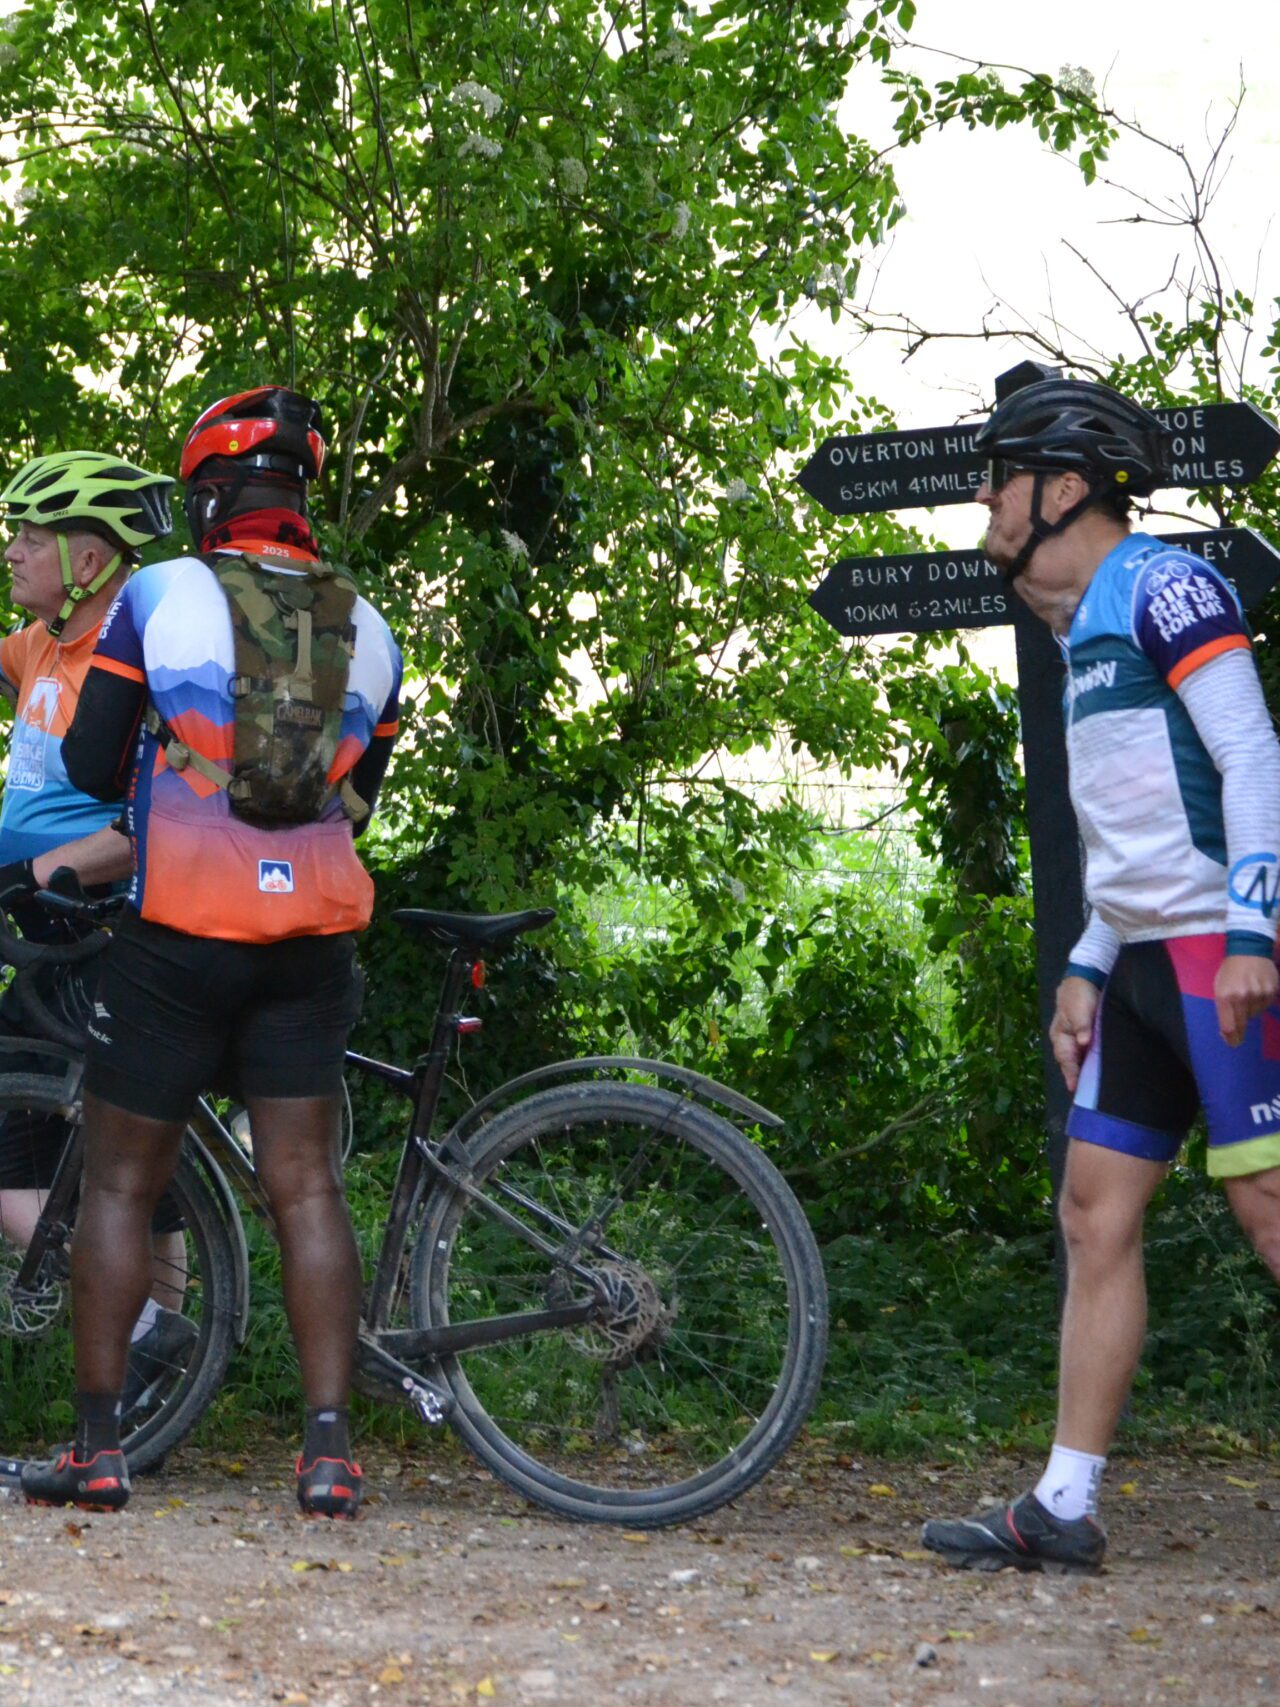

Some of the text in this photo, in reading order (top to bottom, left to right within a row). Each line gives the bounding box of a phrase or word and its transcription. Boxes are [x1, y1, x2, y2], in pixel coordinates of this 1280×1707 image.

[829, 435, 980, 466] OVERTON HIL
[840, 479, 899, 501] 65KM
[262, 545, 290, 557] 2025
[851, 560, 998, 587] BURY DOWN
[1148, 575, 1217, 618] BIKE
[845, 603, 898, 623] 10KM
[1159, 600, 1225, 642] FOR MS
